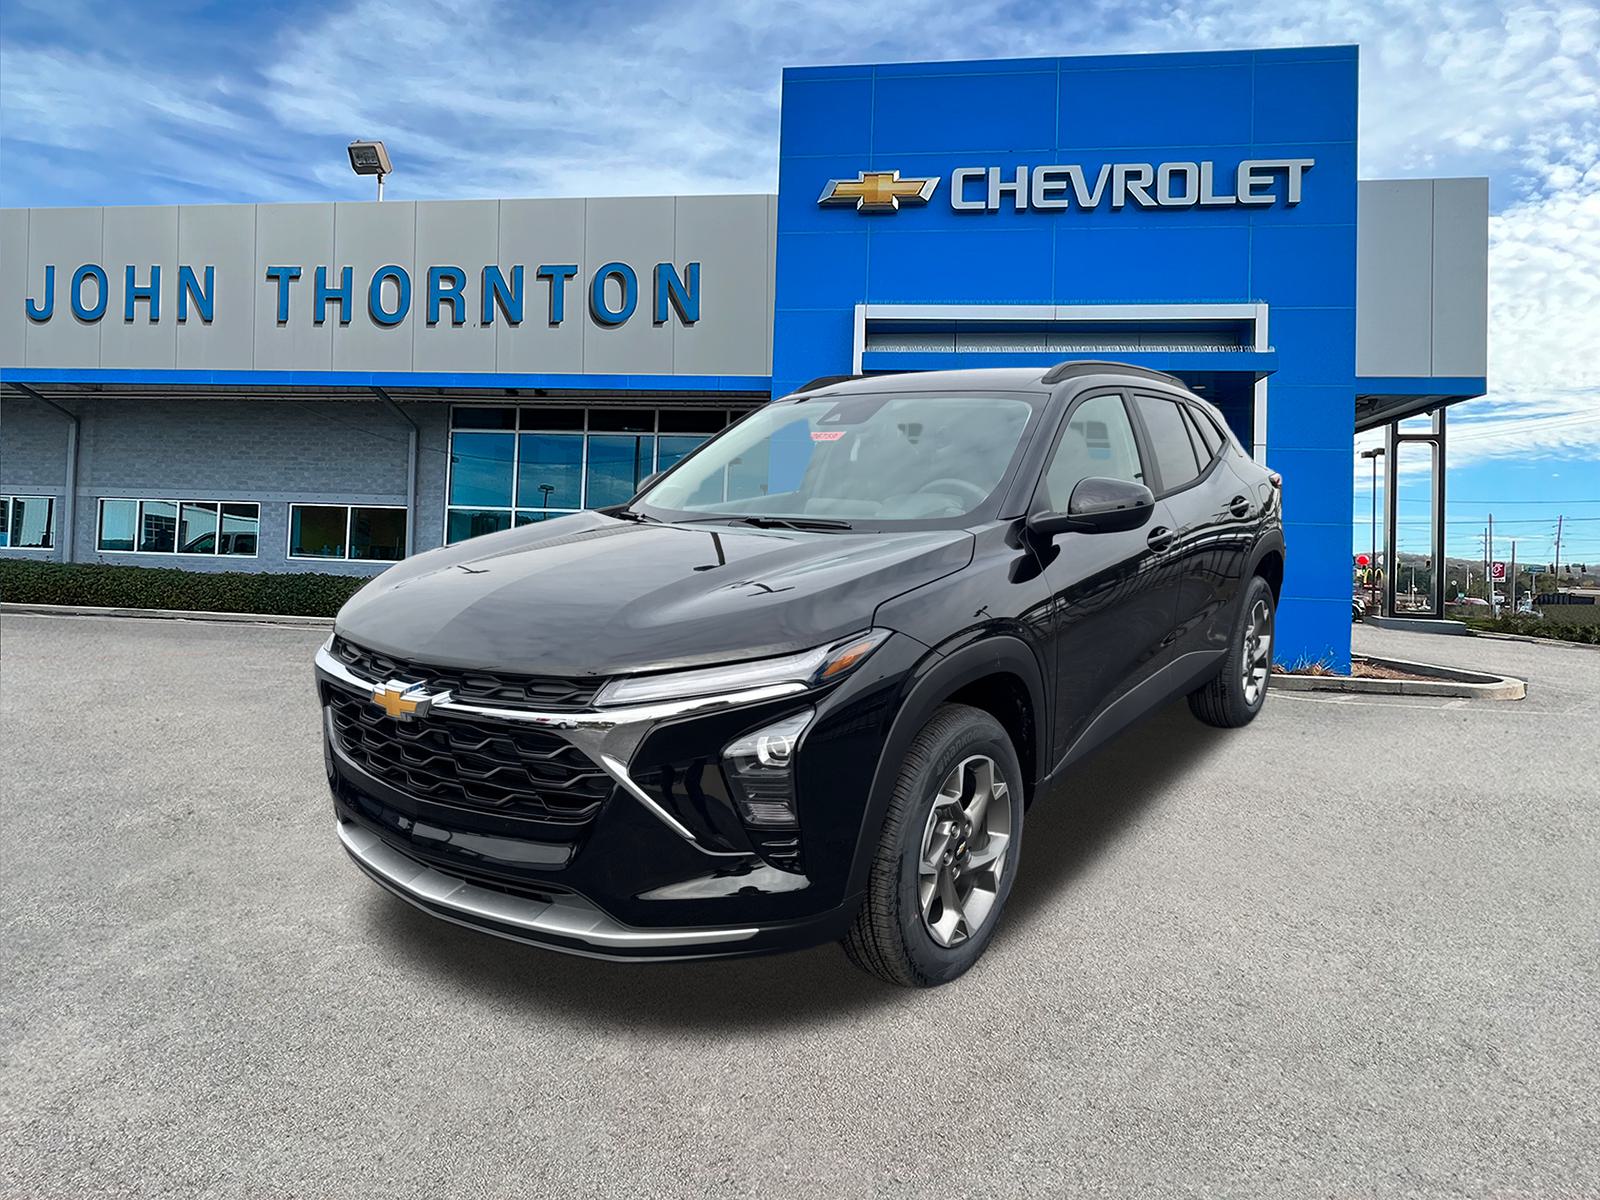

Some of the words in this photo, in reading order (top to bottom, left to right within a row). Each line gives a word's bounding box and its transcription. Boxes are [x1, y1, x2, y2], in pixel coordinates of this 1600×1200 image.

[950, 158, 1316, 212] CHEVROLET
[25, 264, 215, 323] JOHN
[266, 262, 702, 327] THORNTON
[942, 728, 978, 767] Hanko
